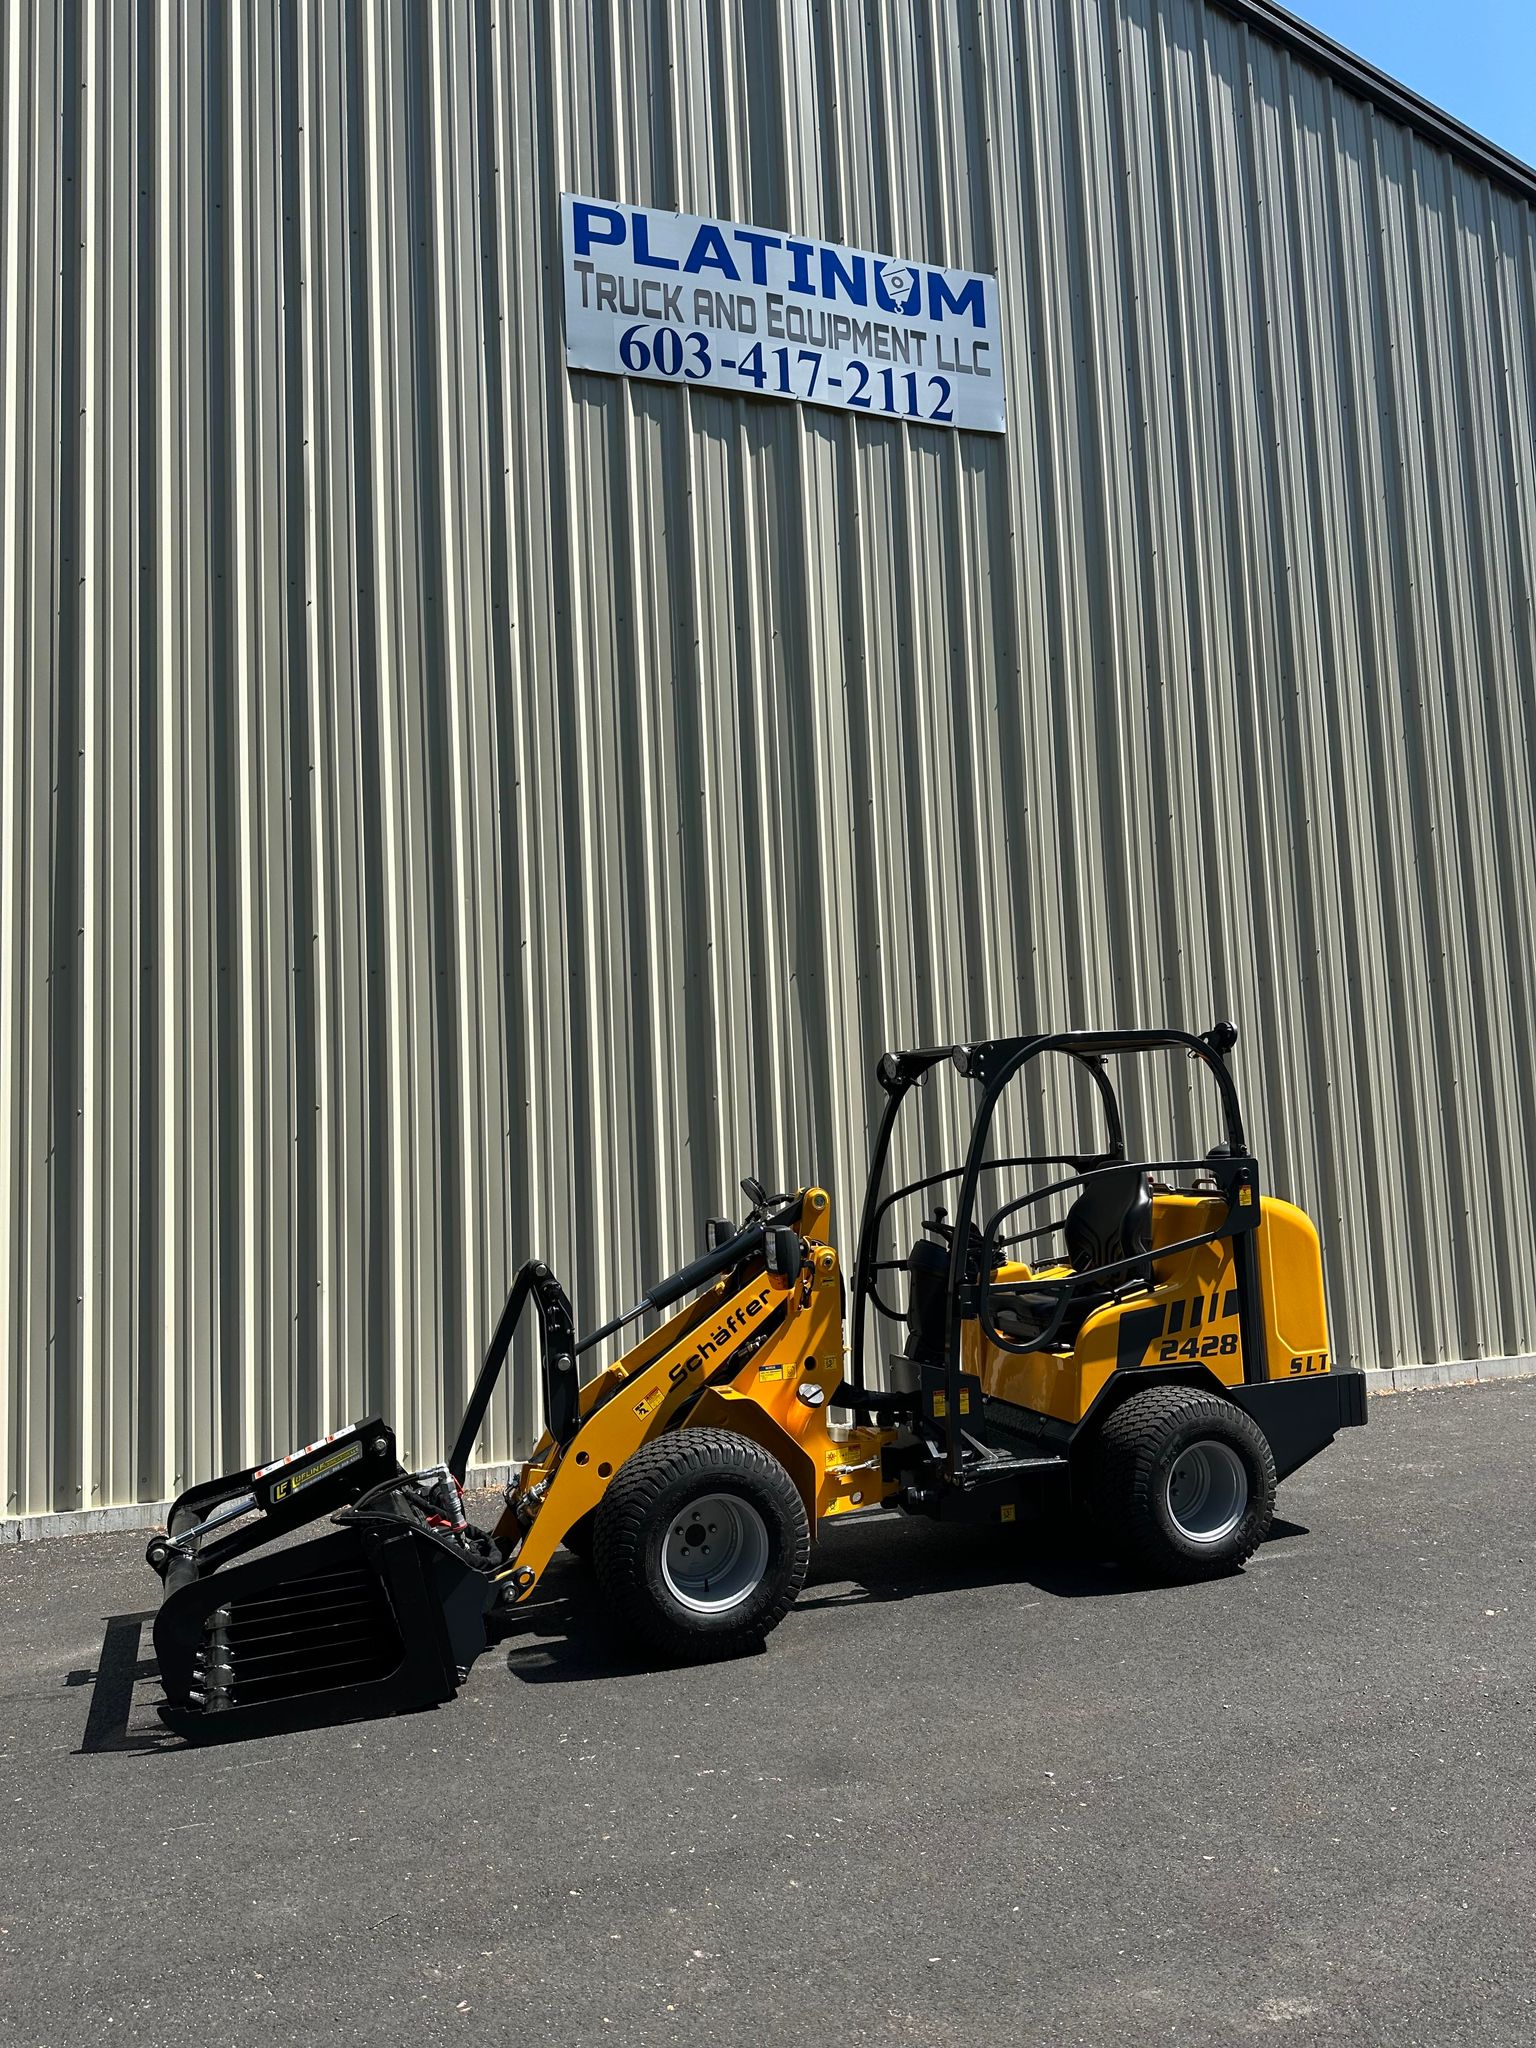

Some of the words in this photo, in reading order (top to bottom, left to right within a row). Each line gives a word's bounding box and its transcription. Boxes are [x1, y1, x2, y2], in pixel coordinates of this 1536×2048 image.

[572, 202, 987, 329] PLATINUM
[573, 260, 684, 323] TRUCK
[694, 288, 757, 335] AND
[767, 292, 927, 367] EQUIPMENT
[936, 336, 991, 377] LLC
[618, 324, 954, 422] 603-417-2112
[668, 1289, 771, 1393] Schäffer
[1159, 1333, 1238, 1362] 2428
[1289, 1353, 1328, 1375] SLT
